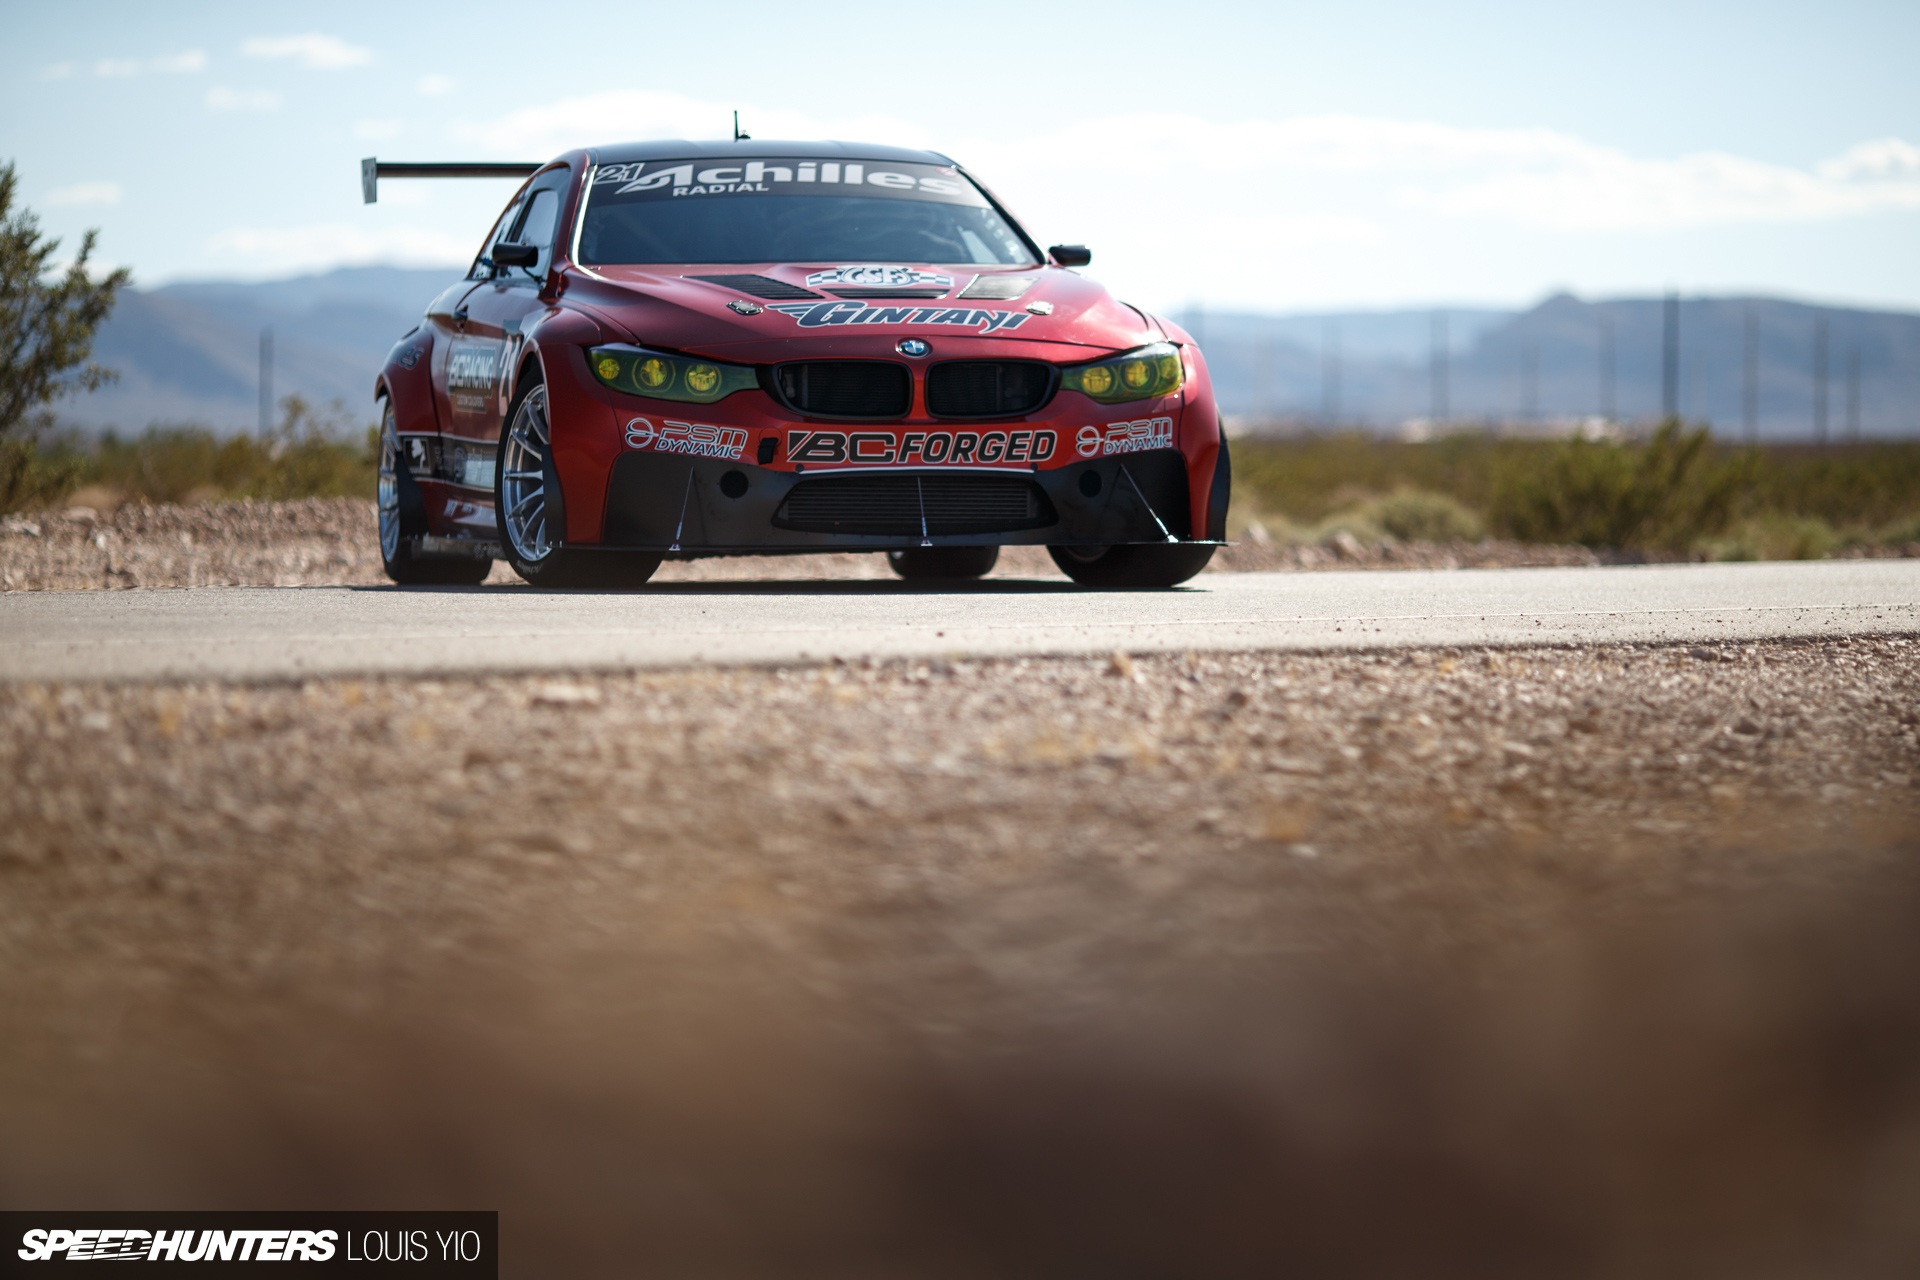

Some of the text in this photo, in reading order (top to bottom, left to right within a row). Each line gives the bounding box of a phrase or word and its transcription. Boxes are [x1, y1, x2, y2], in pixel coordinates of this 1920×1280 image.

[592, 163, 646, 185] 21
[614, 161, 962, 196] Achilles
[672, 182, 770, 197] RADIAL
[796, 300, 1033, 334] GINTANI
[659, 420, 748, 448] PSM
[1105, 417, 1173, 442] PSM
[654, 438, 743, 459] DYNAMIC
[1103, 434, 1173, 455] DYNAMIC
